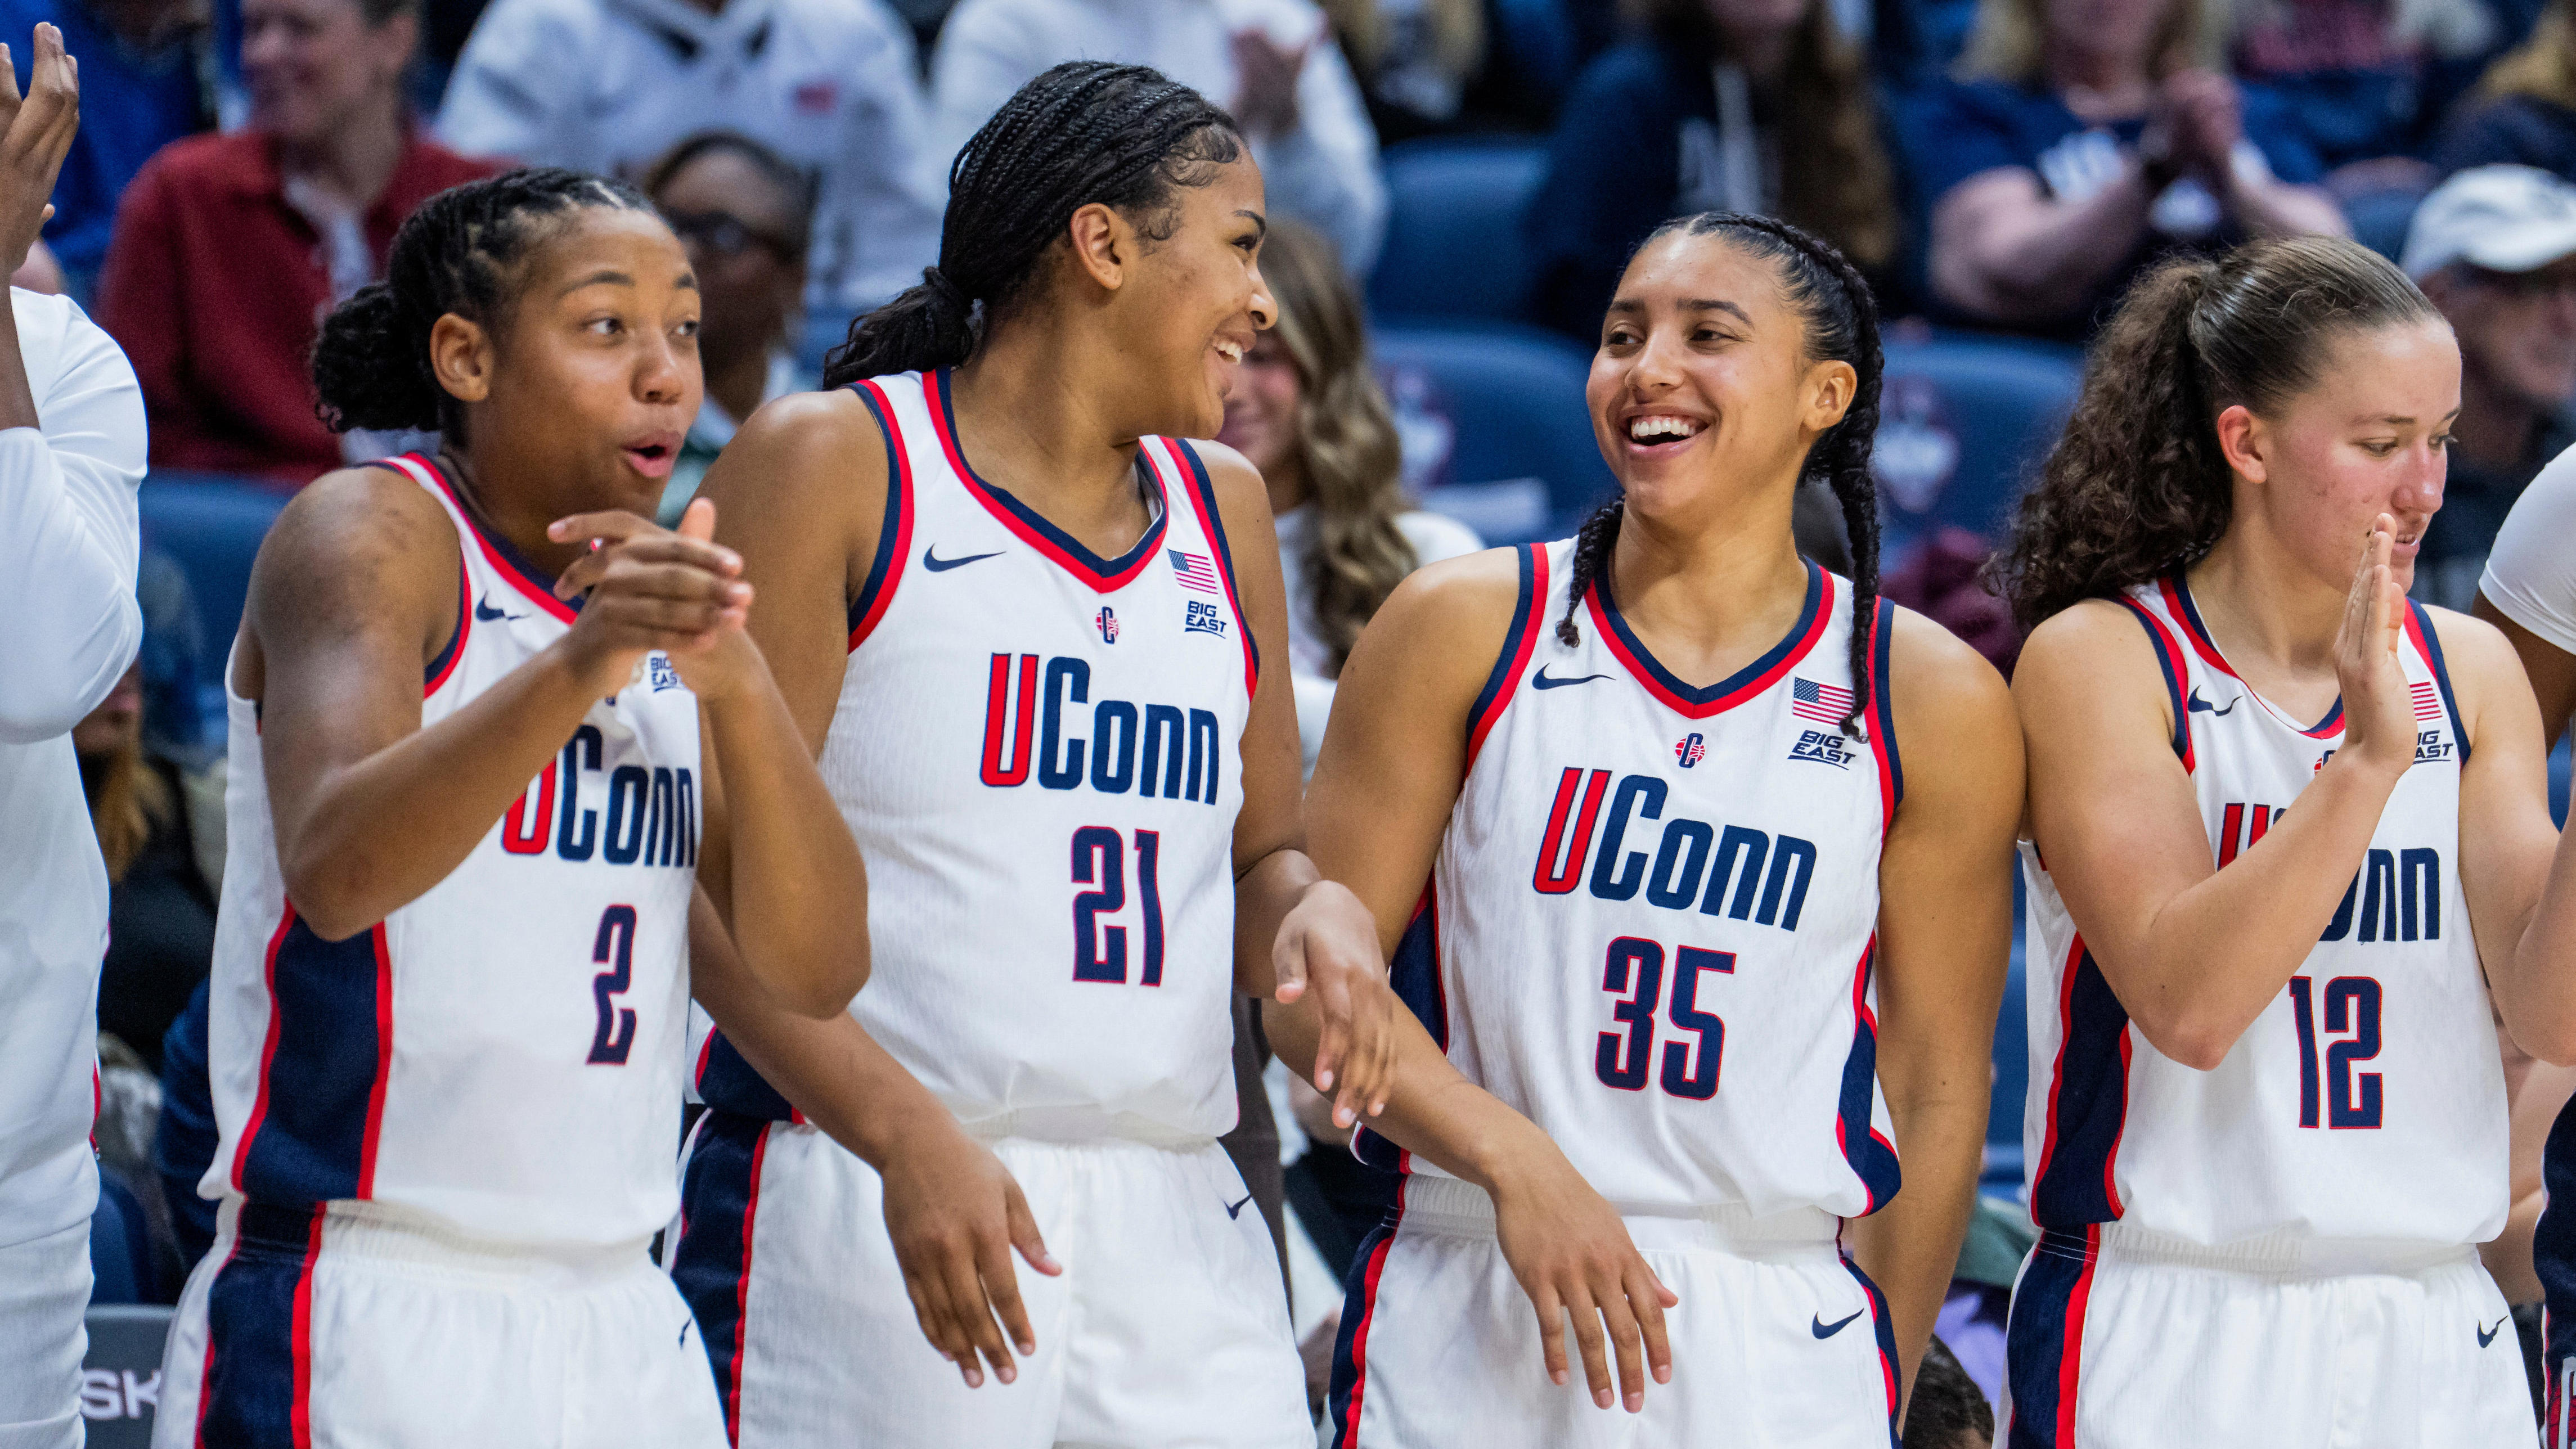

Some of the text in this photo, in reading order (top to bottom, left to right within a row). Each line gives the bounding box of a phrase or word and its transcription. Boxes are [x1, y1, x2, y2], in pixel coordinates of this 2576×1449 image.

[1185, 613, 1227, 633] EAST
[1188, 600, 1217, 618] BIG
[501, 724, 694, 867] UConn
[980, 652, 1220, 806] UConn
[1792, 741, 1856, 764] EAST
[1800, 730, 1846, 749] BIG
[2415, 743, 2453, 759] AST
[2417, 730, 2440, 746] IG
[1071, 826, 1165, 988] 21
[1532, 767, 1817, 932] UConn
[585, 903, 637, 1065] 2
[1595, 935, 1737, 1101] 35
[2289, 975, 2383, 1130] 12
